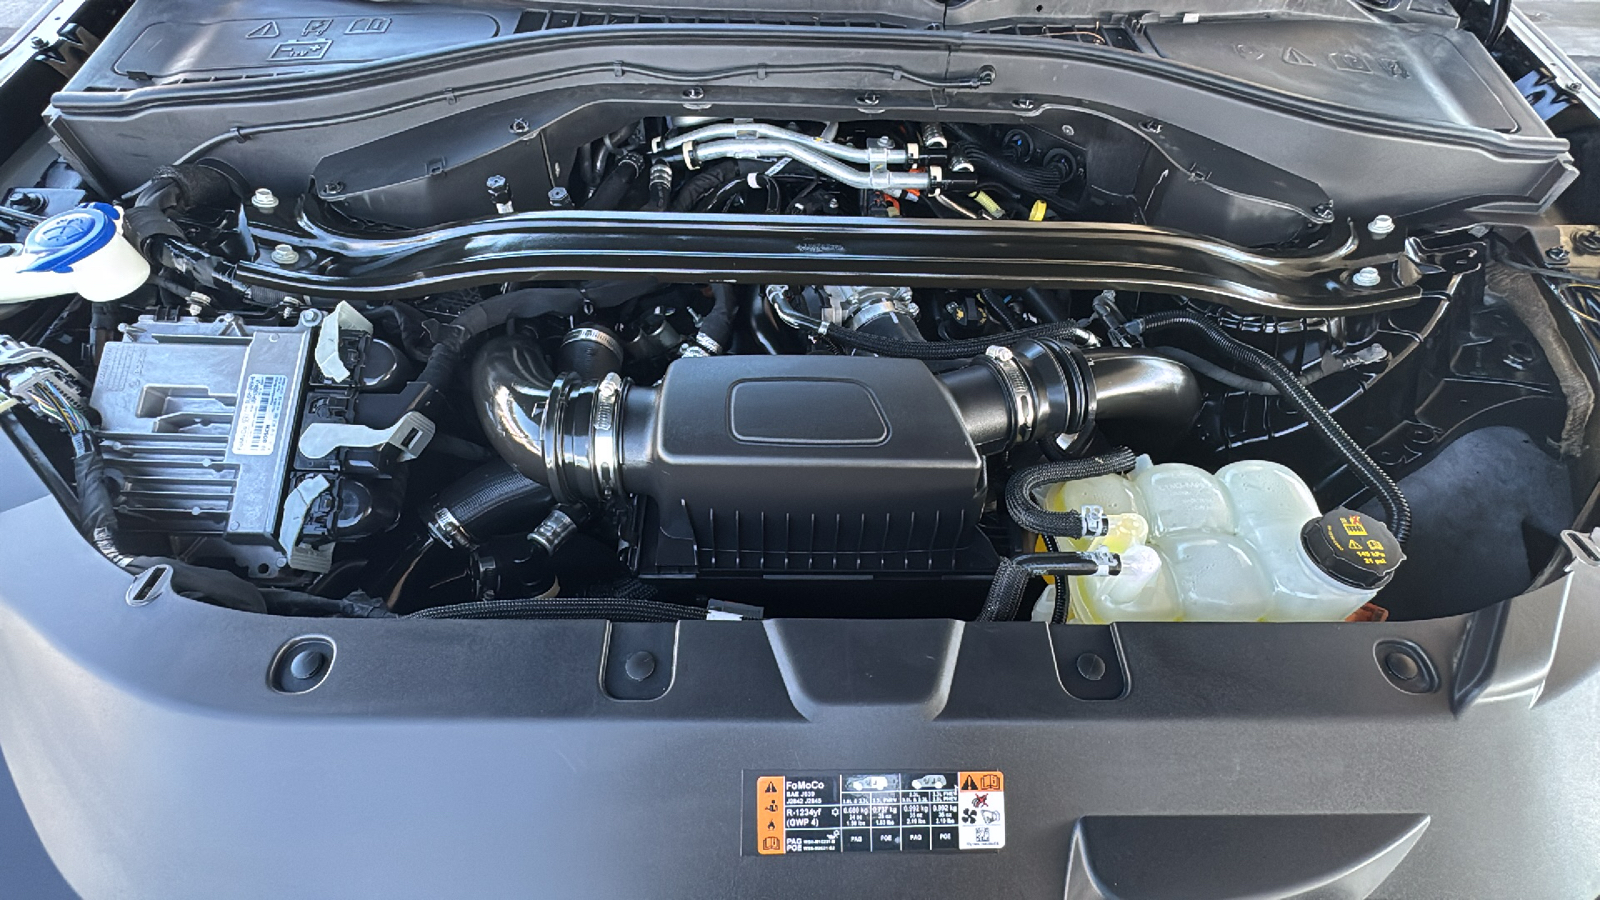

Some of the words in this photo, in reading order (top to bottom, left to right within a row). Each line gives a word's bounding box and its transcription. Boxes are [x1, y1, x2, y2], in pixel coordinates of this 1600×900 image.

[786, 780, 825, 790] FoMoCo
[786, 807, 822, 817] R-1234yf
[786, 817, 810, 827] (GWP
[811, 817, 819, 827] 4)
[786, 837, 803, 845] PAG
[786, 844, 803, 852] POE
